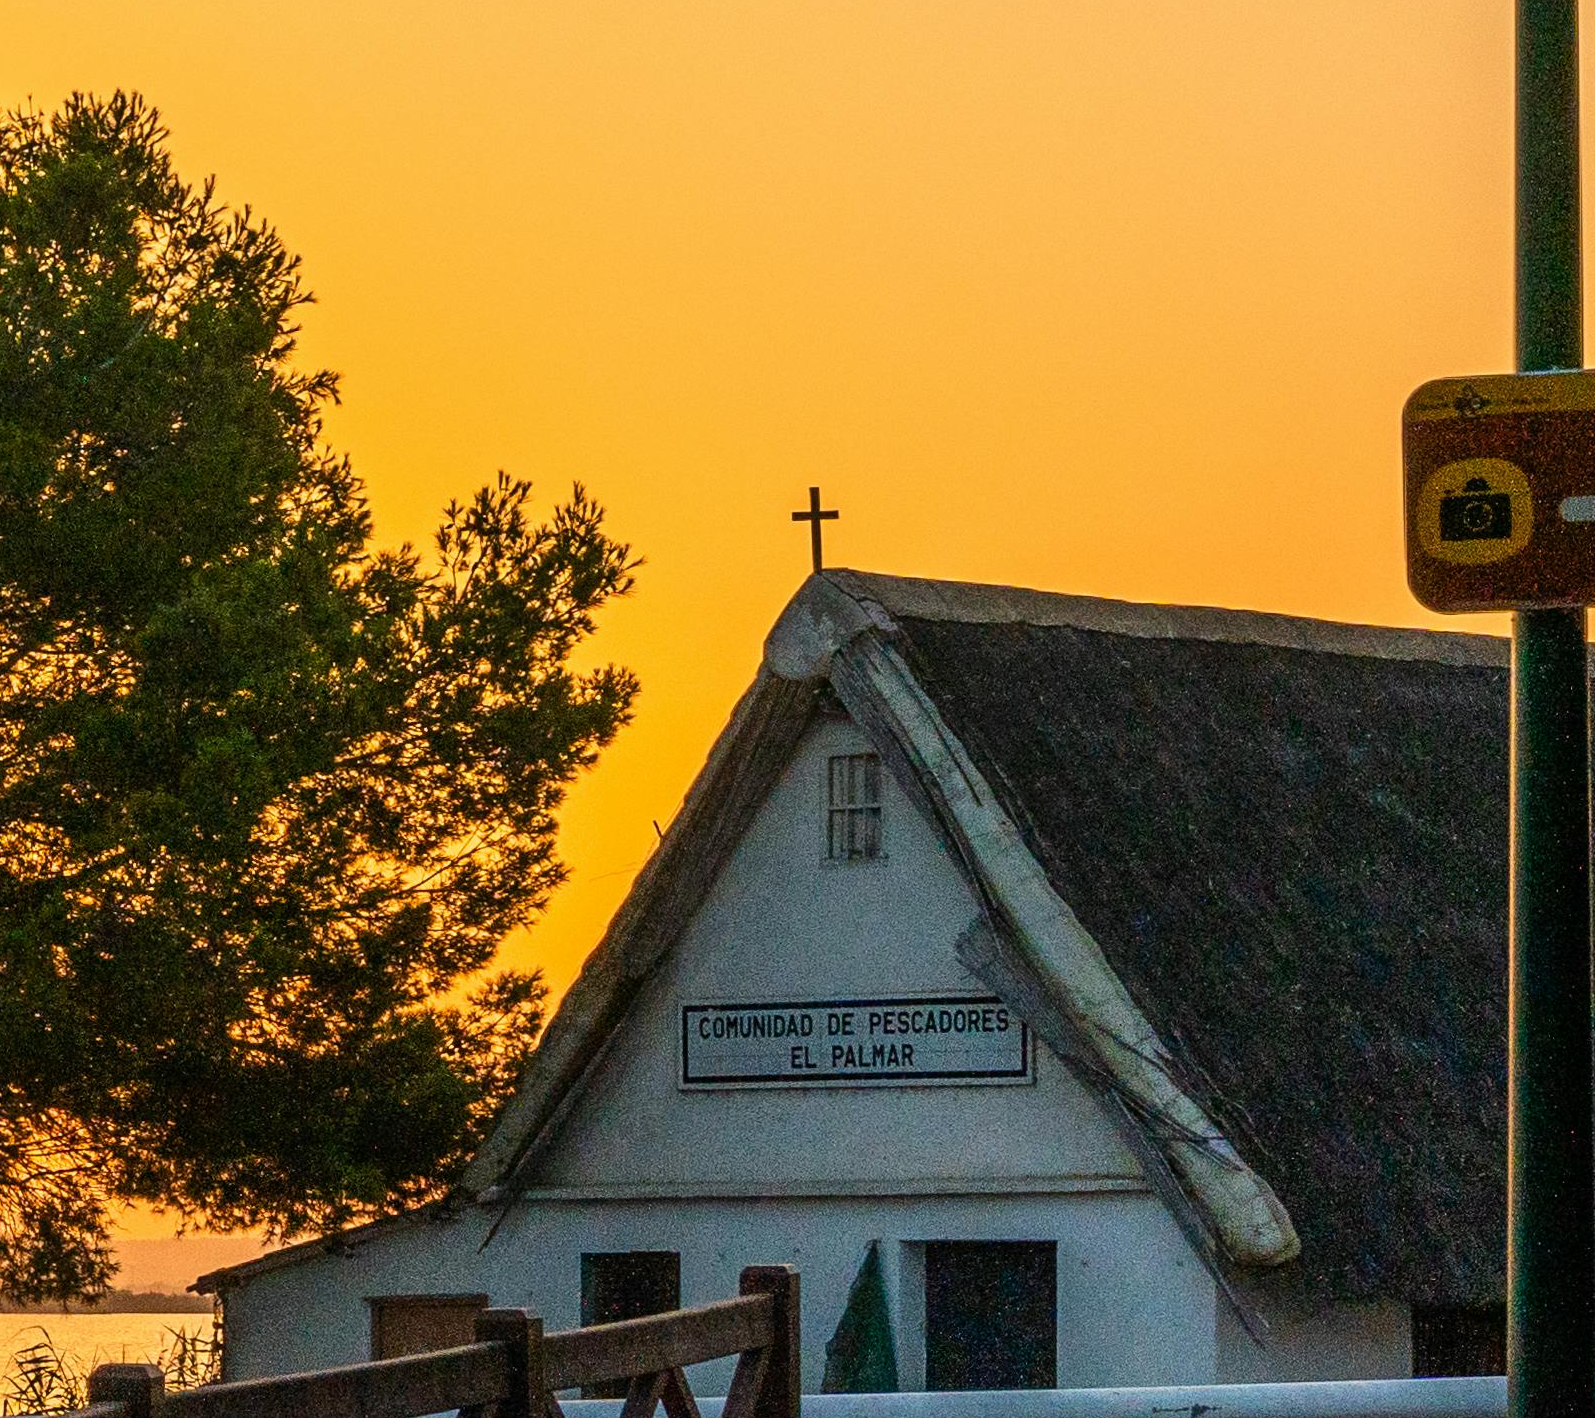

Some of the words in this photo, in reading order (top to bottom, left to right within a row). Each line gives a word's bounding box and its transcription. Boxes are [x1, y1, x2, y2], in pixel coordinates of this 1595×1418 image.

[699, 1014, 813, 1040] COMUNIDAD
[827, 1013, 855, 1036] DE
[869, 1009, 1010, 1035] PESCADORES
[790, 1046, 817, 1069] EL
[831, 1044, 915, 1069] PALMAR
